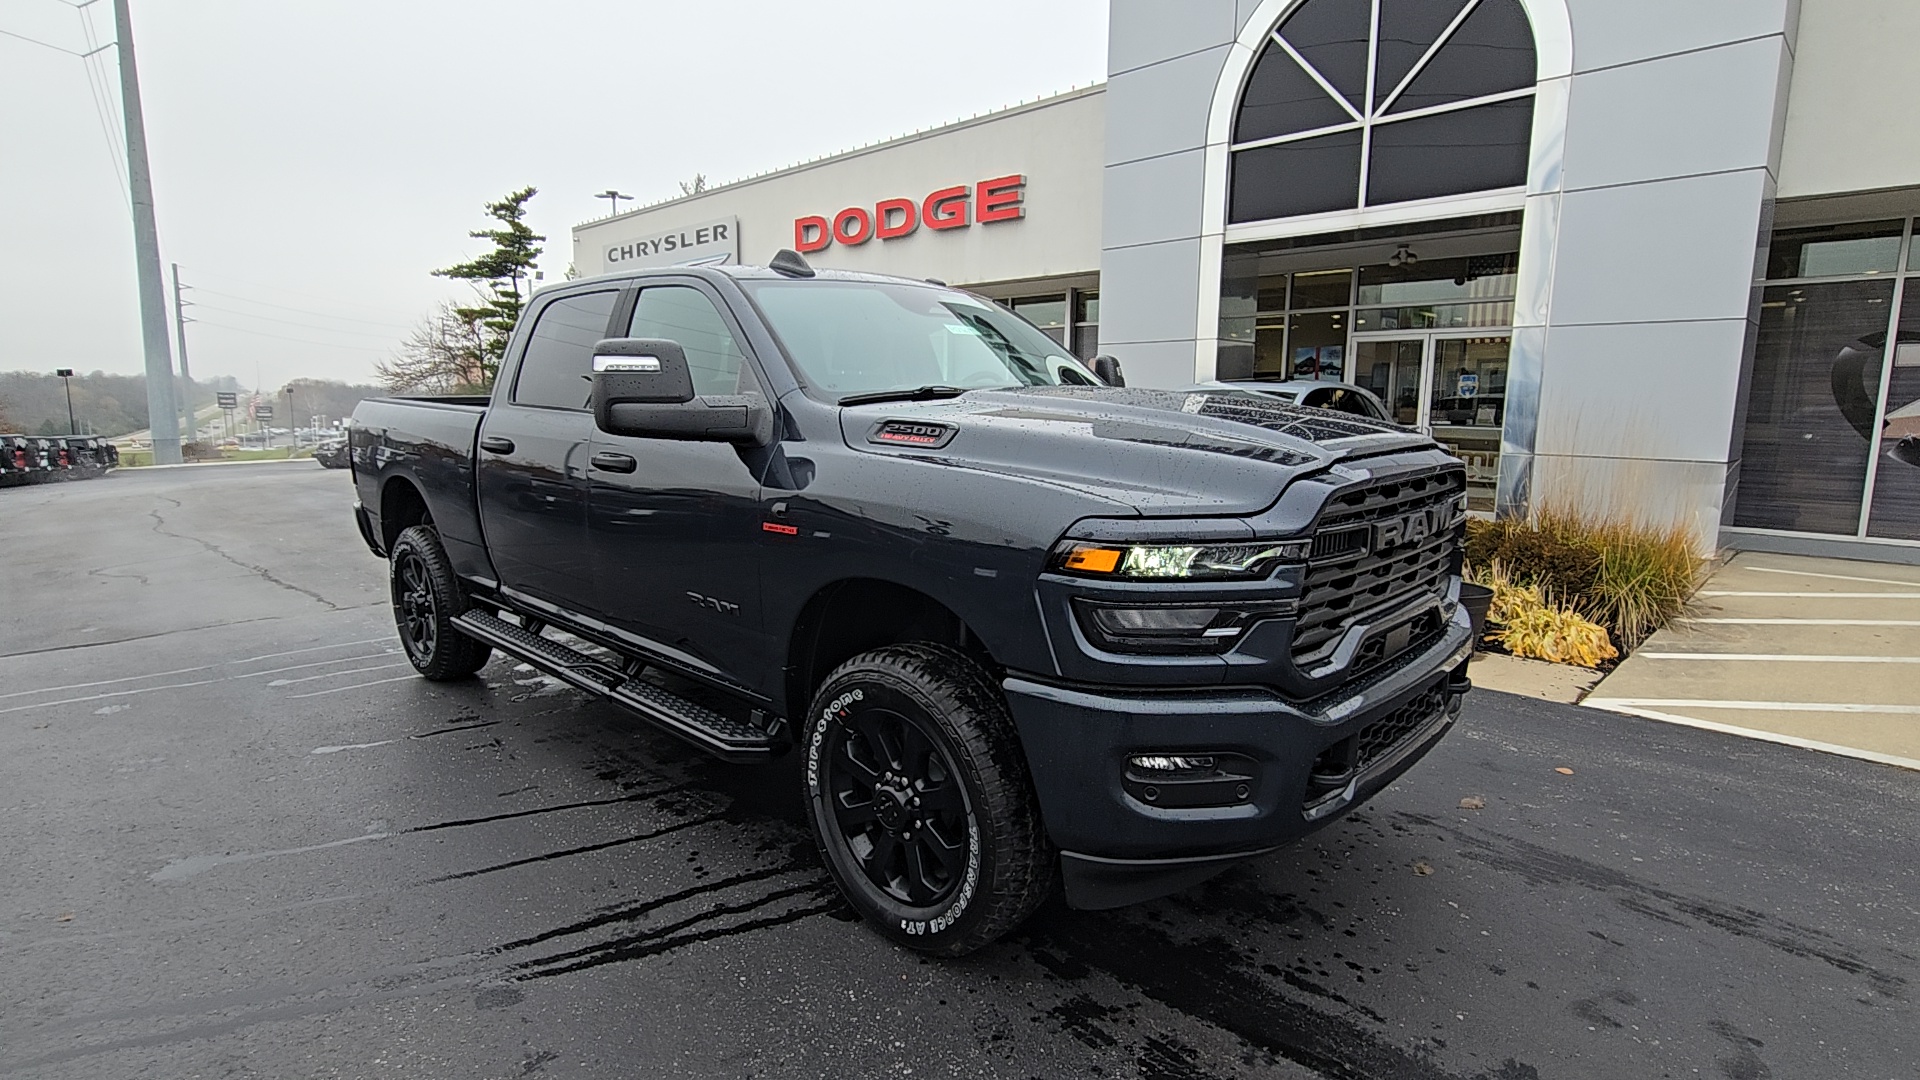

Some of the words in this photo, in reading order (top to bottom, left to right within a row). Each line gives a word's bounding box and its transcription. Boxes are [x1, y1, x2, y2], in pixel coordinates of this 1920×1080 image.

[794, 173, 1026, 253] DODGE
[607, 223, 728, 263] CHRYSLER
[883, 423, 943, 436] 2500
[1373, 499, 1453, 551] RAM
[929, 826, 981, 934] TRANSFORCE
